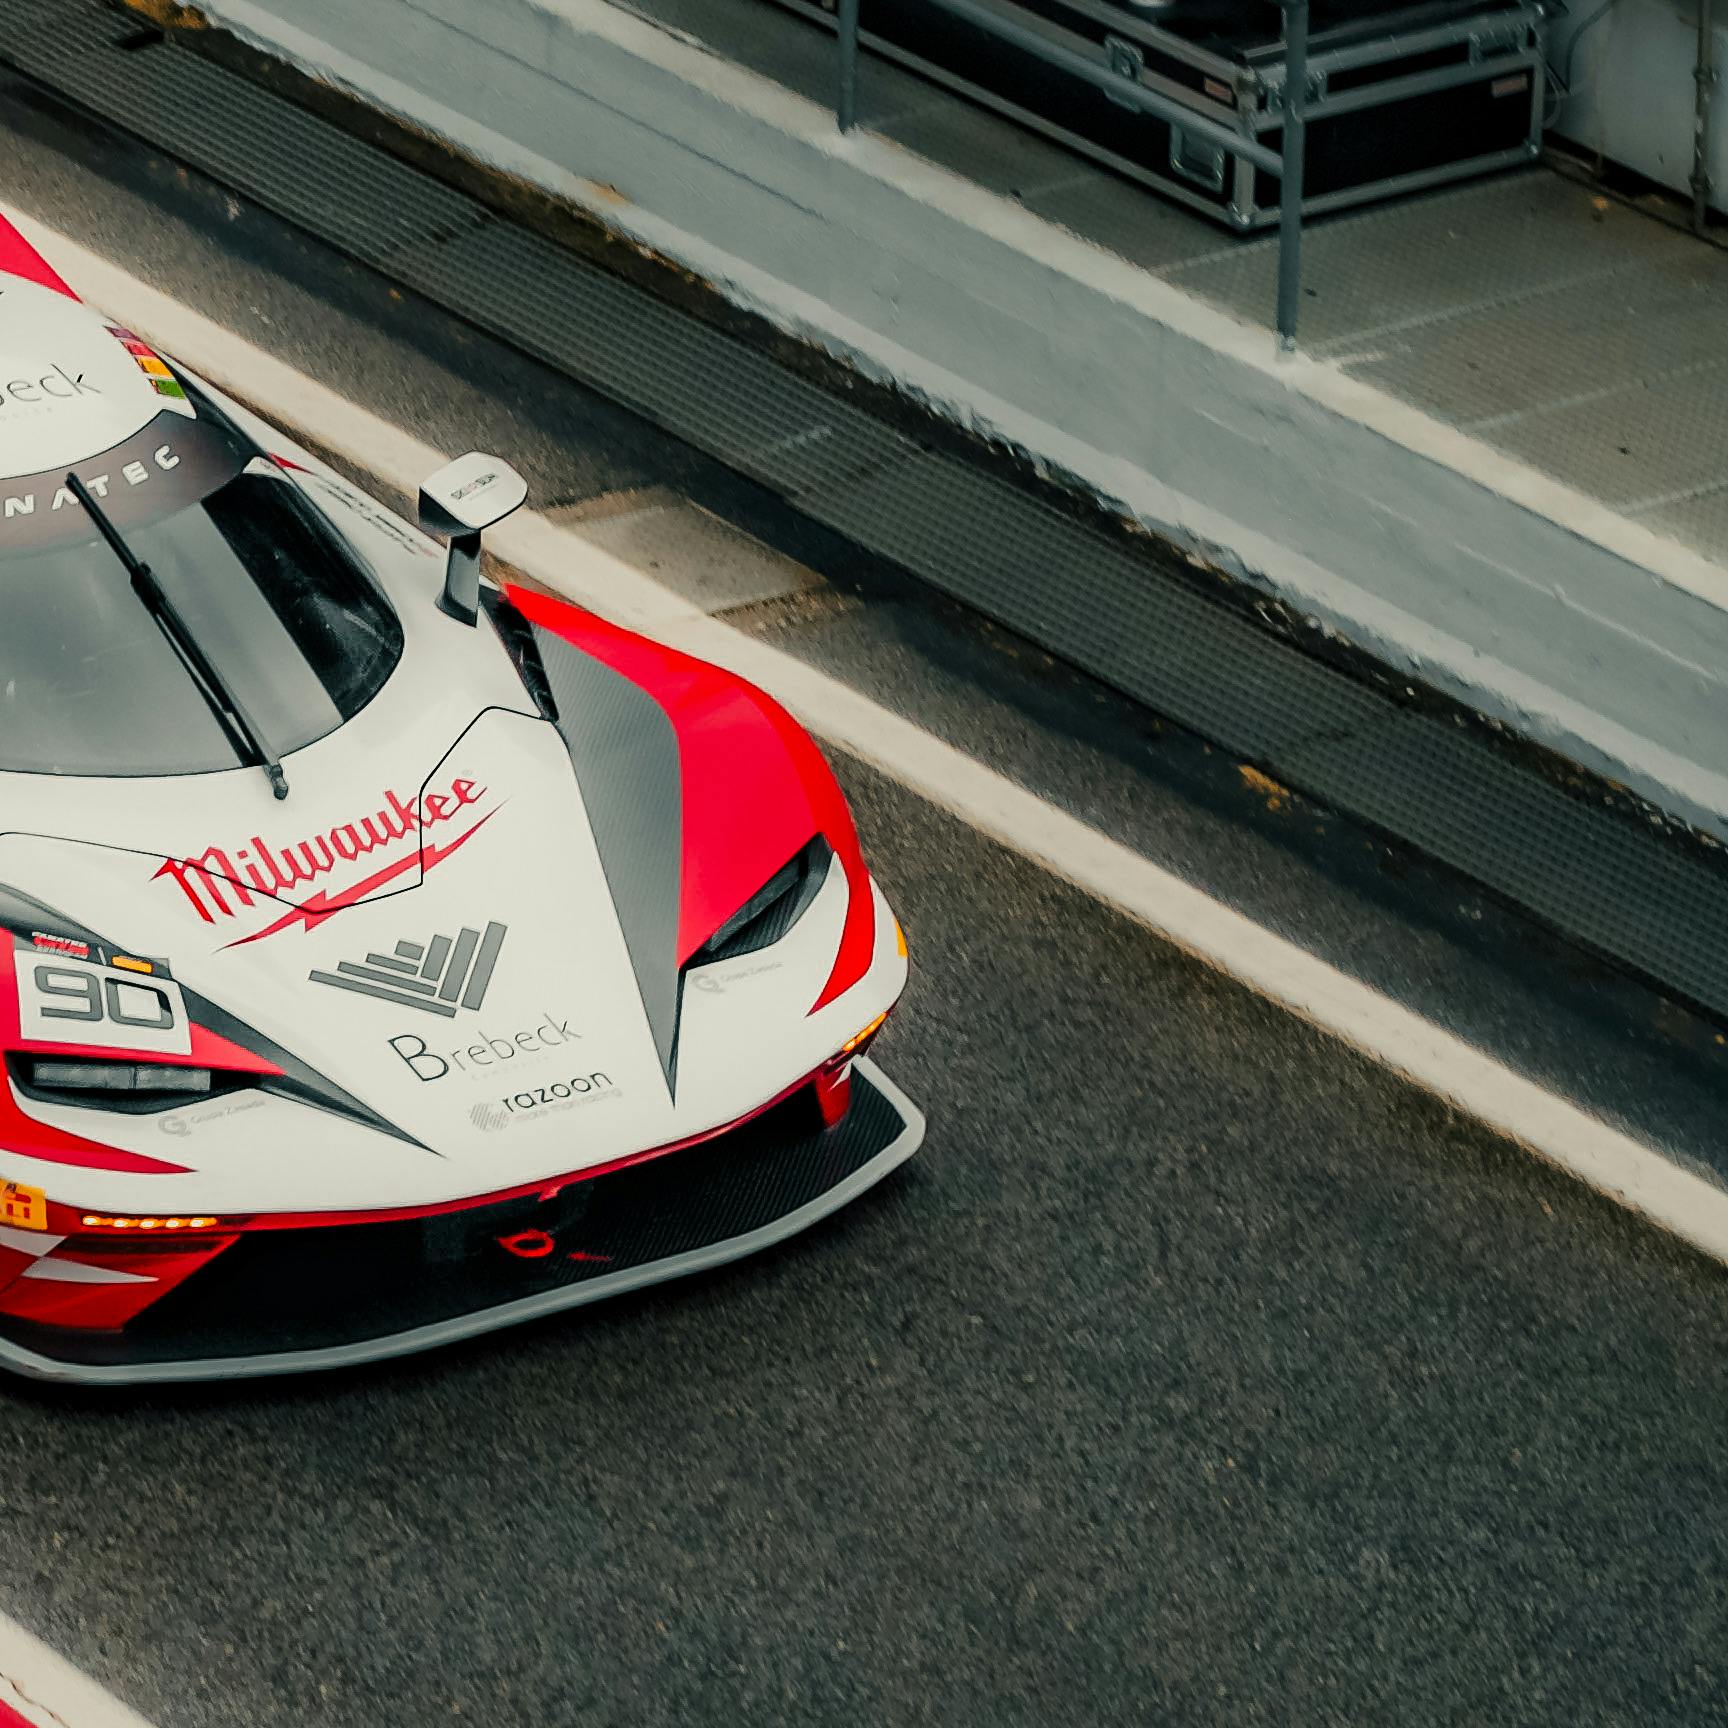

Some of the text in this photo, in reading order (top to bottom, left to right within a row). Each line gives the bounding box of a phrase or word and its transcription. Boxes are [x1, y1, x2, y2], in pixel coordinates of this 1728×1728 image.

[148, 777, 488, 925] Milwaukee
[34, 965, 175, 1030] 90
[387, 1013, 584, 1081] Brebeck
[502, 1072, 613, 1112] razoon
